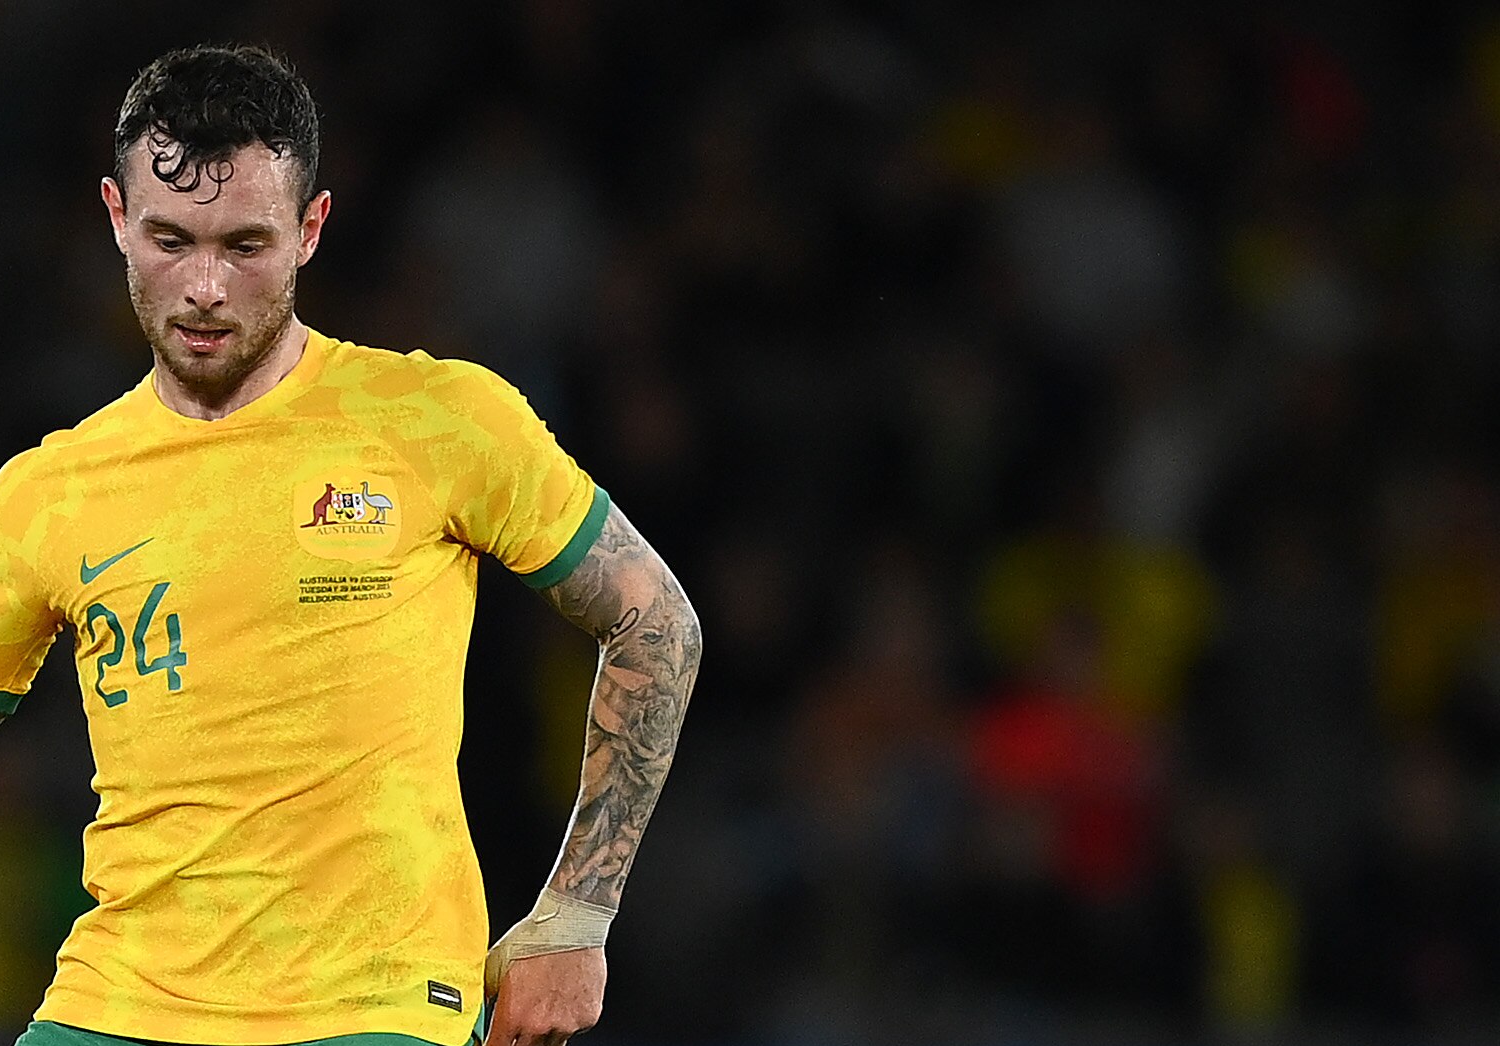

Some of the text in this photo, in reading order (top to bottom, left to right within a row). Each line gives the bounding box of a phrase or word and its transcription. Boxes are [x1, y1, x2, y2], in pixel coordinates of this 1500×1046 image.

[316, 525, 385, 535] AUSTRALIA
[299, 576, 347, 584] AUSTRALIA
[299, 585, 339, 594] TUESDAY
[350, 584, 375, 592] MARCH
[353, 592, 393, 601] AUSTRALIA
[86, 581, 187, 708] 24
